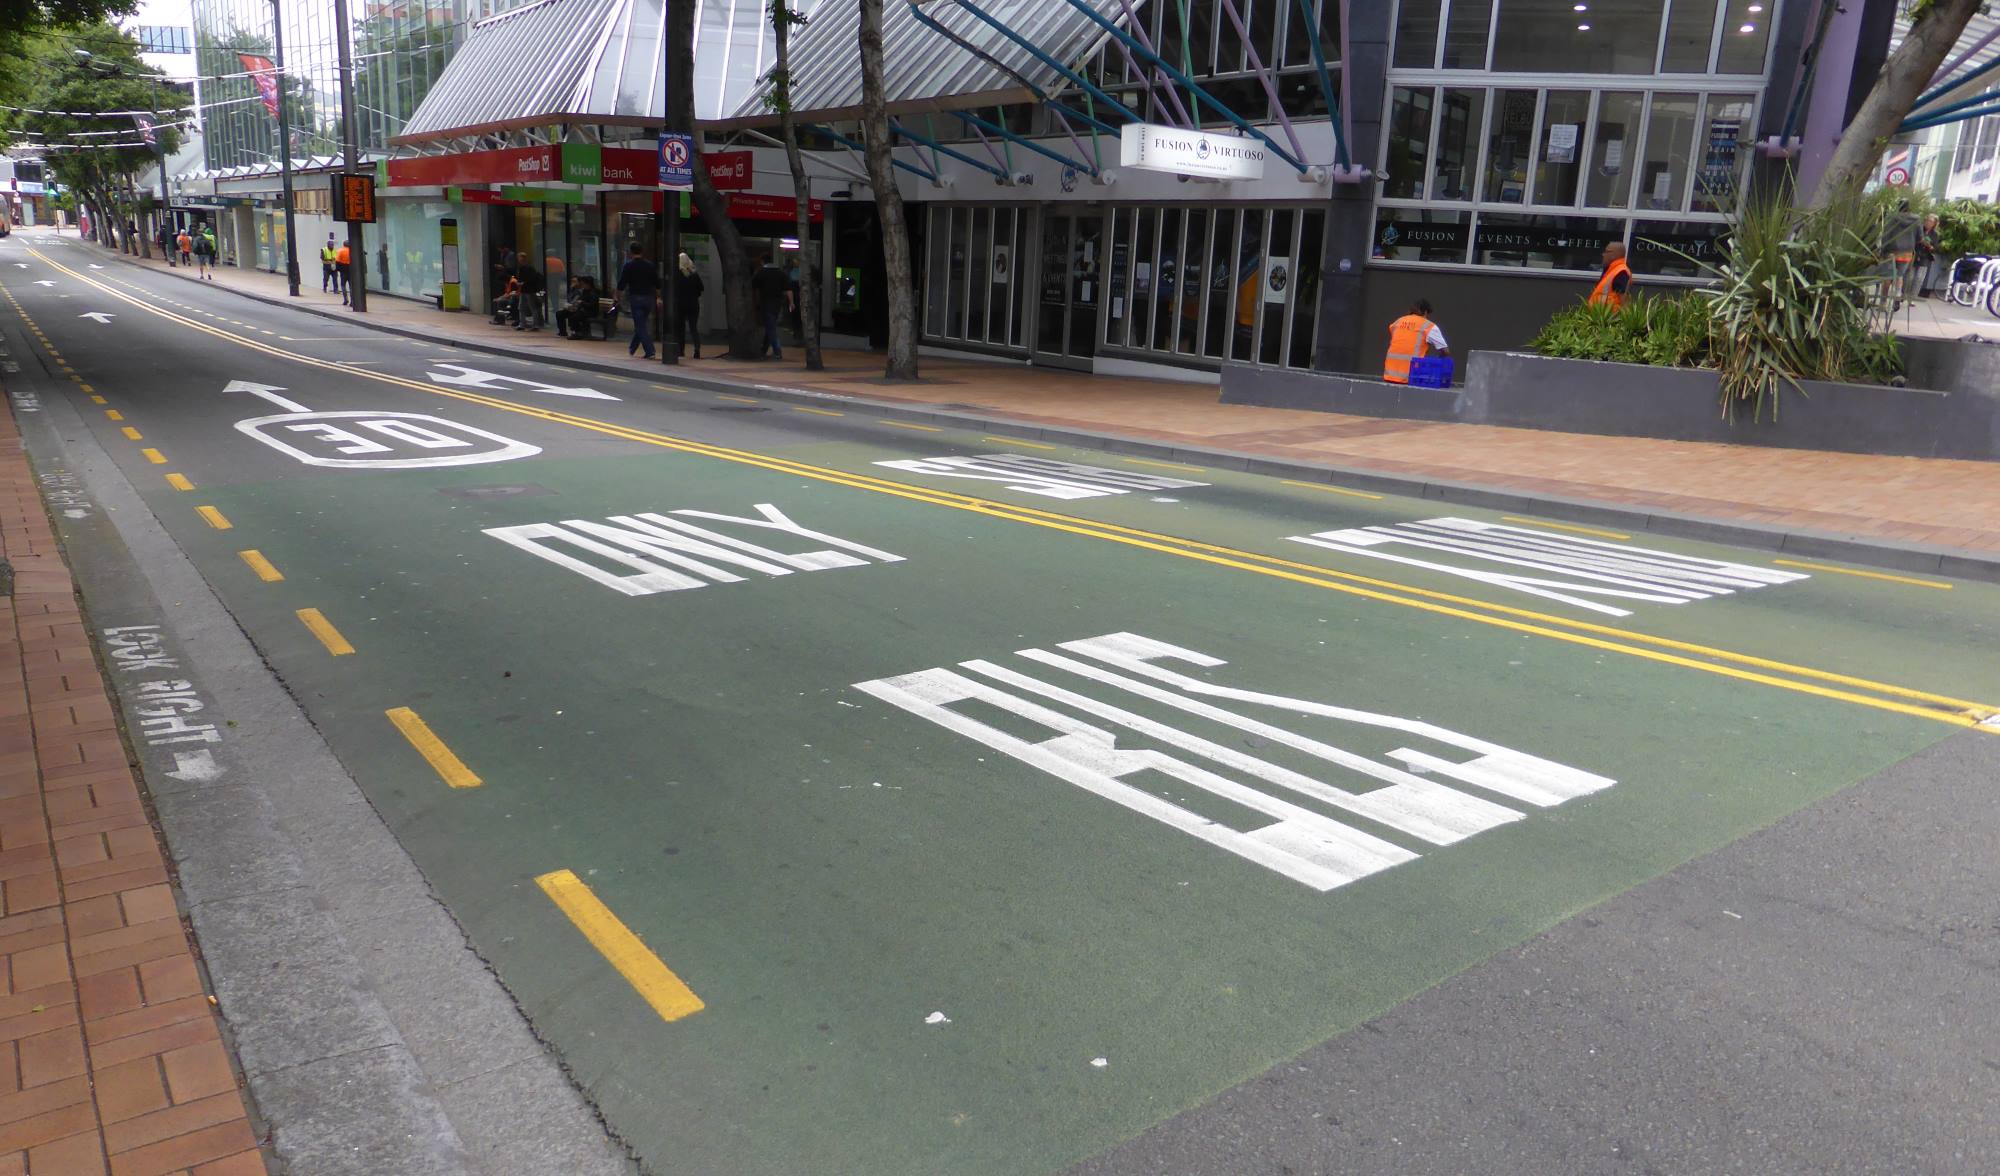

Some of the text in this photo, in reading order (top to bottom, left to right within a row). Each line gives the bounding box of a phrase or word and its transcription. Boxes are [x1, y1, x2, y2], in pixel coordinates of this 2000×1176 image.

[1154, 138, 1193, 152] FUSION
[1213, 146, 1264, 161] VIRTUOSO
[518, 156, 540, 174] PostShop
[569, 164, 633, 179] kiwi bank
[710, 165, 734, 181] PostShop
[1891, 173, 1903, 181] 30
[1407, 230, 1456, 242] FUSION
[1478, 234, 1531, 245] EVENTS
[285, 419, 475, 455] 30
[871, 453, 1214, 500] BUS
[480, 502, 907, 596] ONLY
[1280, 516, 1813, 617] ONLY
[103, 624, 223, 746] LOOK RIGHT
[850, 630, 1619, 892] BUS
